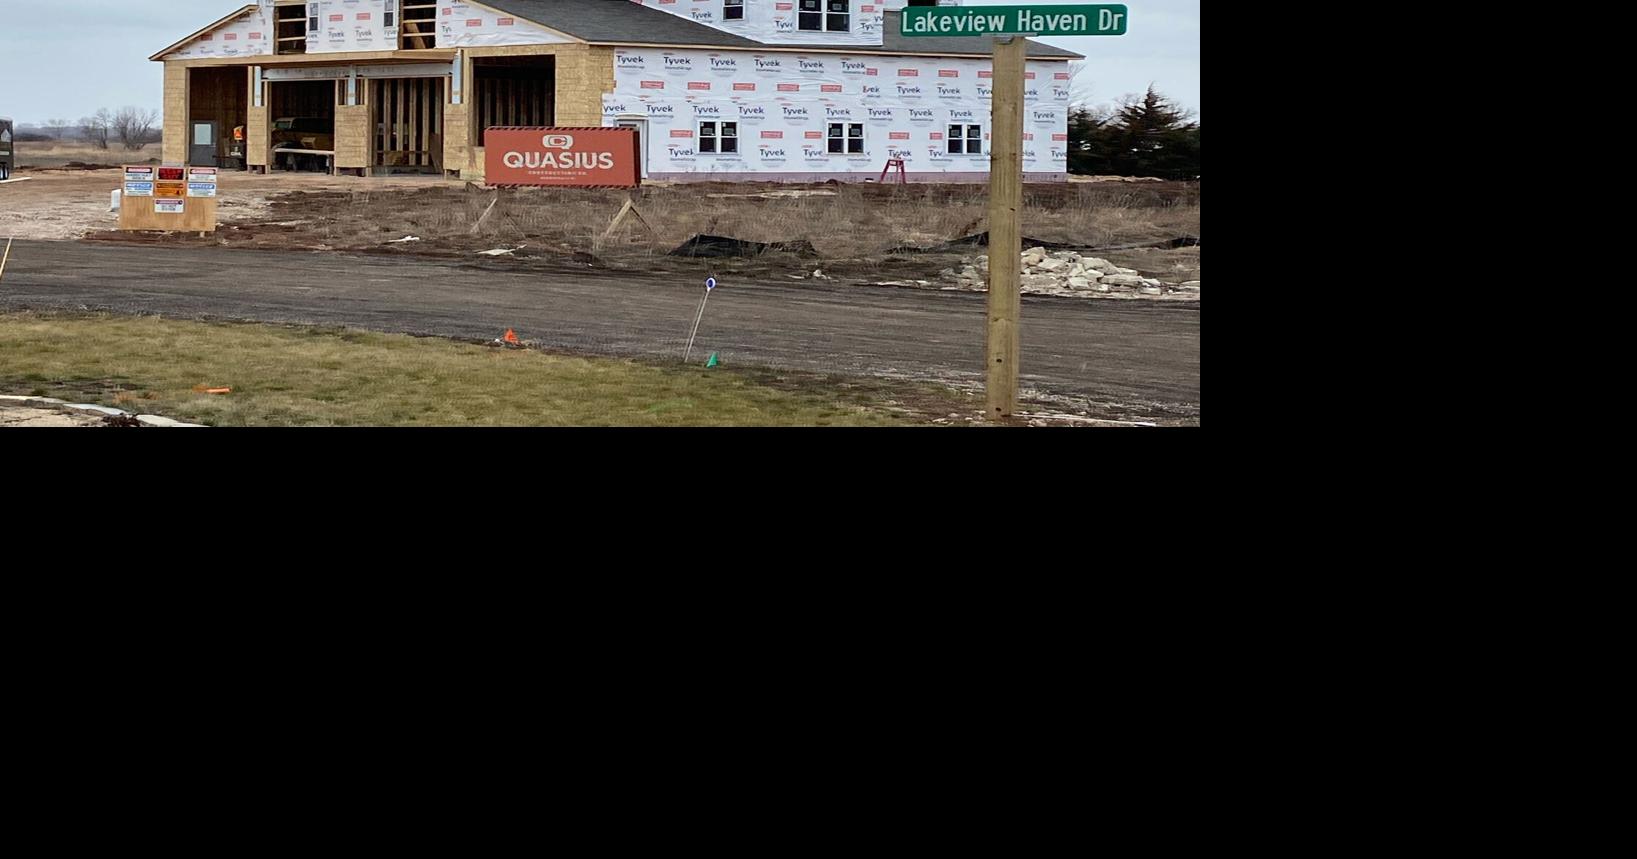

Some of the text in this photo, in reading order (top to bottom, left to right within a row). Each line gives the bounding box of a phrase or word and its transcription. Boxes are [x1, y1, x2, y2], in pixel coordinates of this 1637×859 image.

[776, 20, 792, 28] Tyv
[902, 8, 1124, 32] Lakeview Haven Dr
[616, 55, 644, 64] Tyvek
[664, 56, 691, 65] Tyvek
[710, 58, 736, 66] Tyvek
[754, 59, 781, 67] Tyvek
[798, 60, 824, 69] Tyvek
[842, 62, 866, 70] Tyvek
[603, 105, 626, 113] yvek
[646, 104, 673, 113] Tyvek
[693, 105, 719, 114] Tyvek
[738, 106, 764, 114] Tyvek
[783, 107, 808, 115] Tyvek
[826, 108, 850, 116] Tyvek
[760, 149, 784, 157] Tyvek
[804, 149, 822, 157] Tyve
[503, 152, 613, 169] QUASIUS
